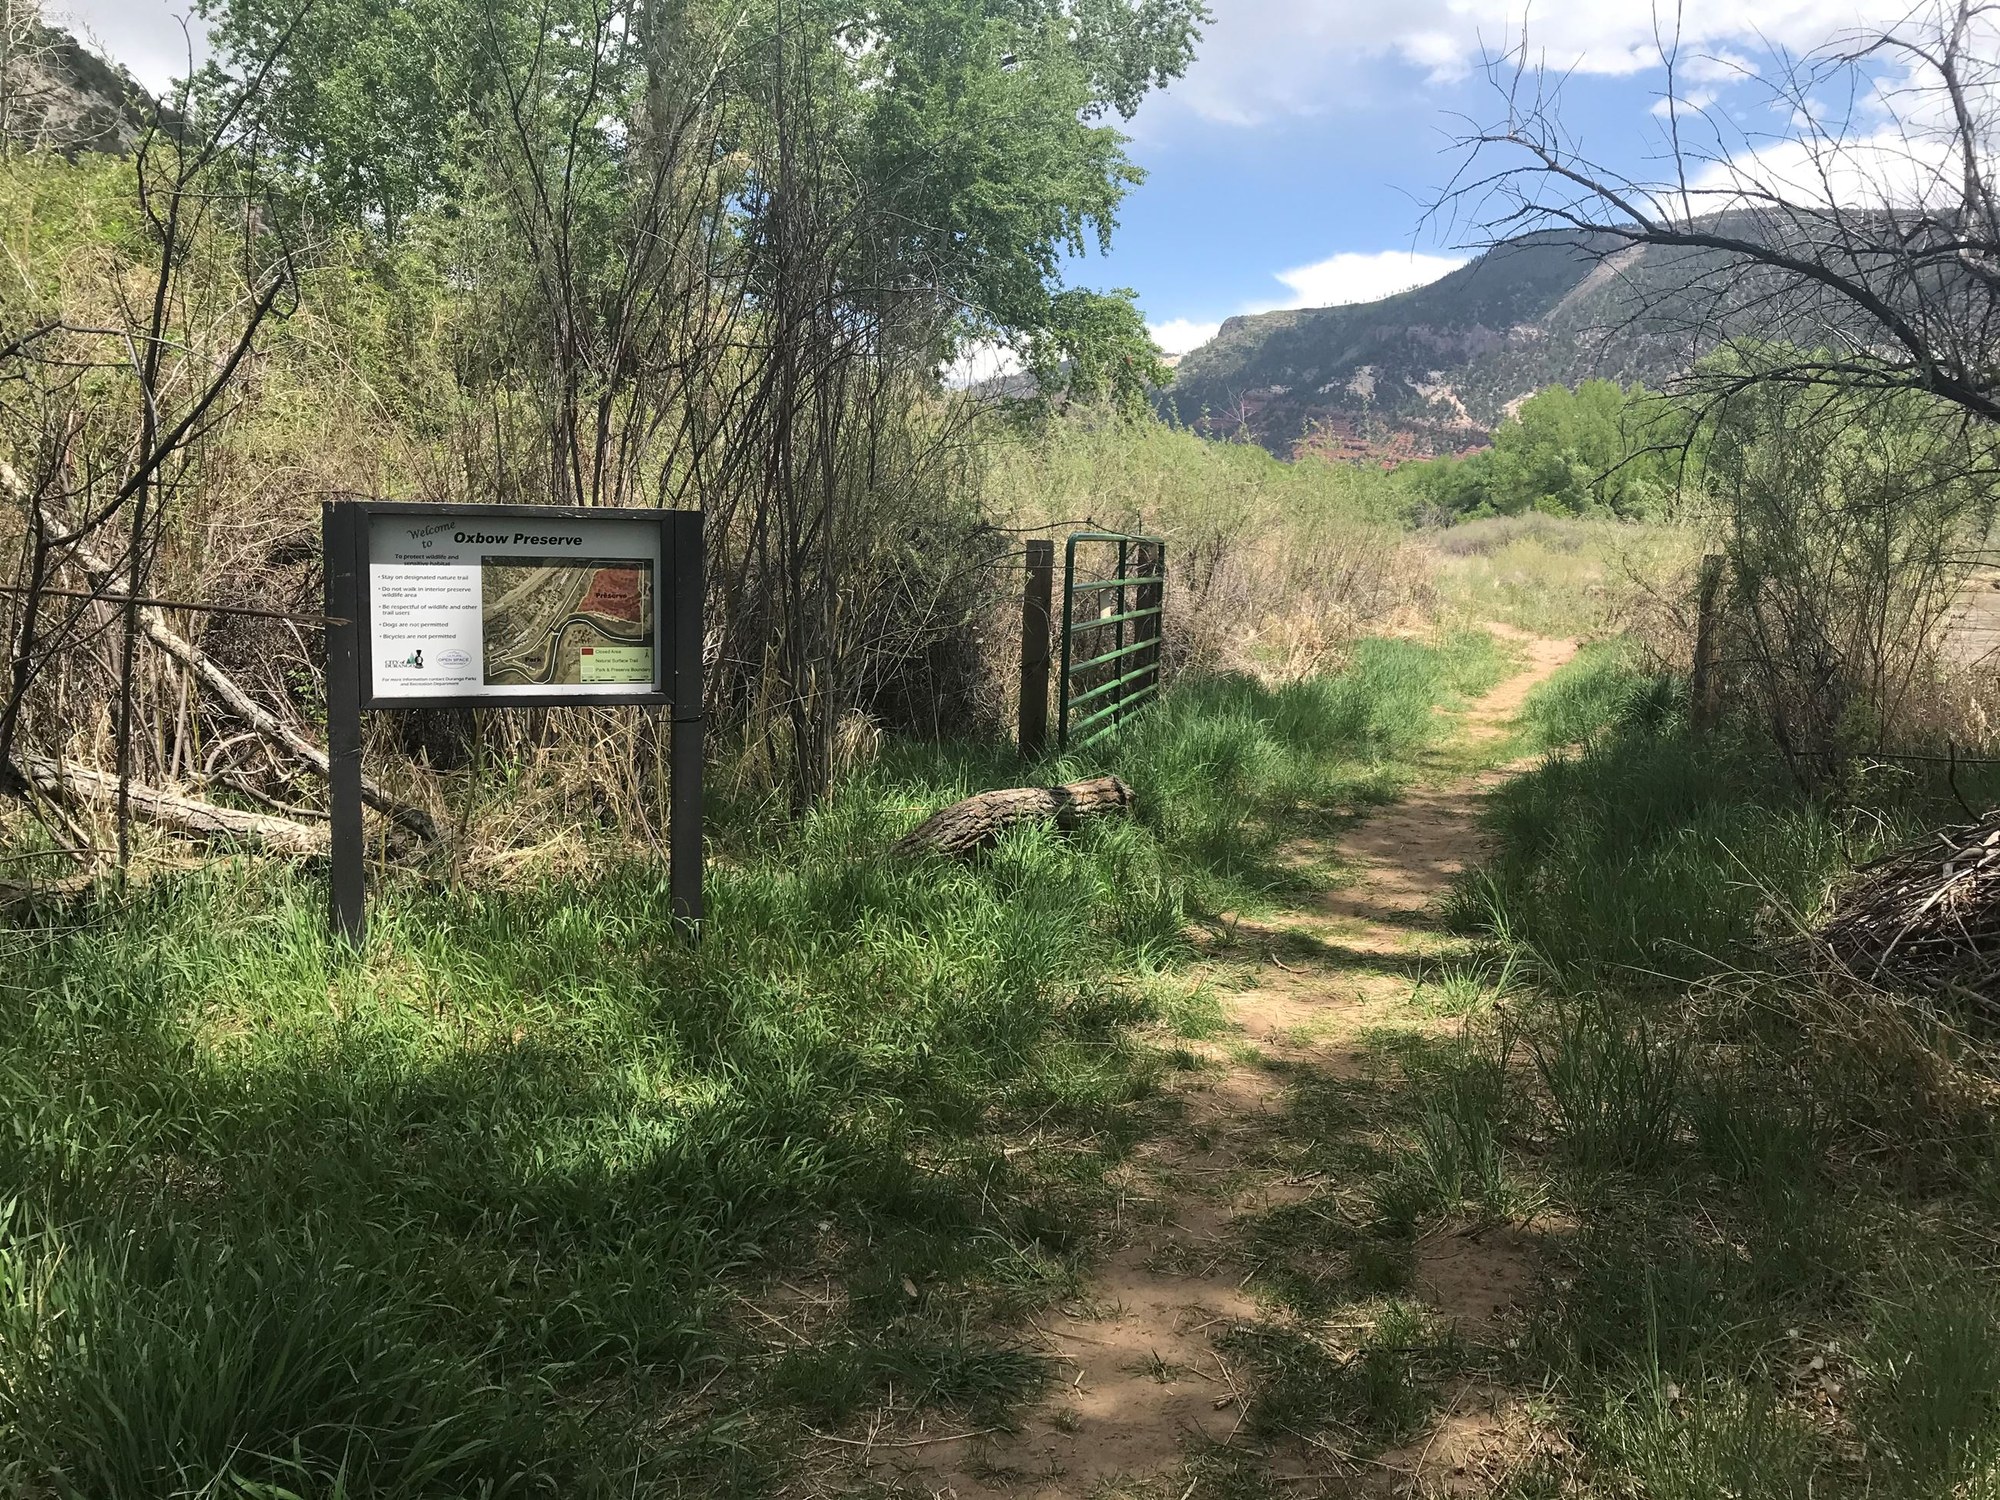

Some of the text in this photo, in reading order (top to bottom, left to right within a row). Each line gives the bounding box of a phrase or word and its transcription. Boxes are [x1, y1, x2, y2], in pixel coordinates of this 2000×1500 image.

[406, 521, 456, 540] Welcome
[422, 540, 432, 549] to
[454, 532, 582, 546] Oxbow Preserve
